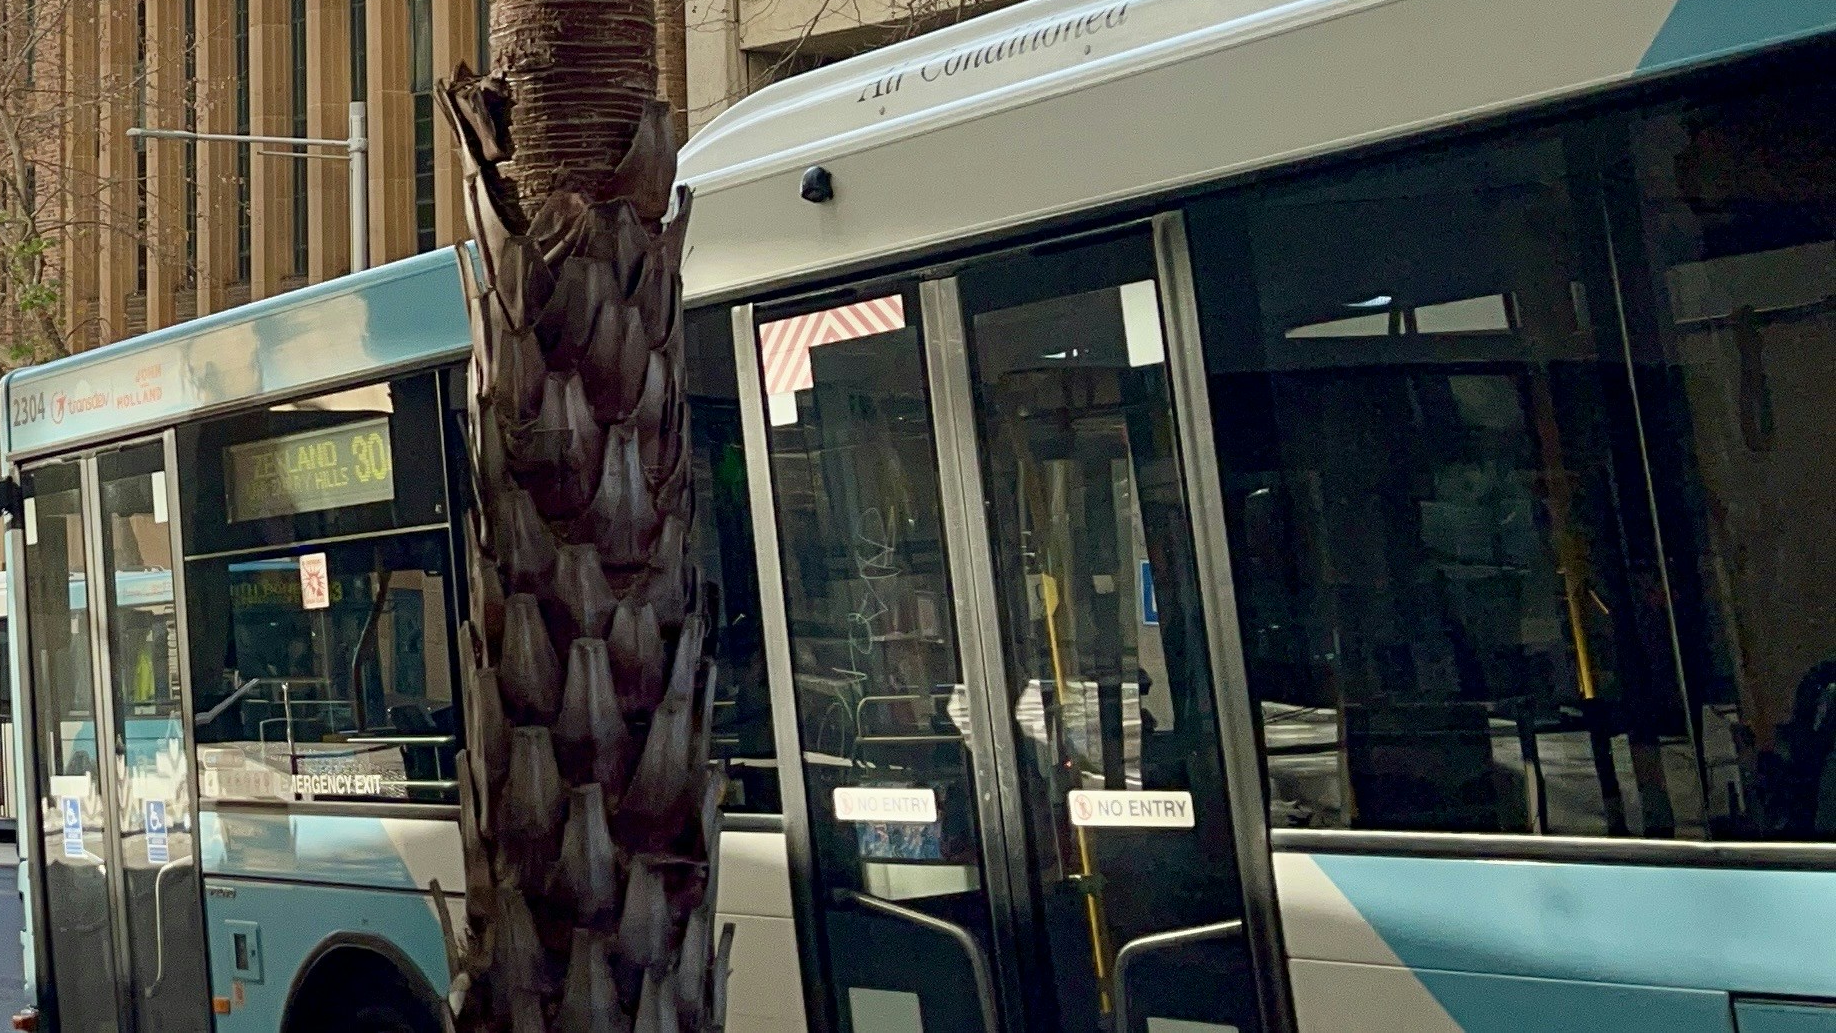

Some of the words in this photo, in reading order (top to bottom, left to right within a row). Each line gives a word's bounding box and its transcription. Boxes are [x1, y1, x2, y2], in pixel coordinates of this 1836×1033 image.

[858, 61, 909, 103] Air
[13, 392, 45, 428] 2304
[116, 386, 162, 410] HOLLAND
[251, 440, 338, 480] ZELAND
[351, 432, 388, 483] 30
[355, 774, 381, 794] EXIT
[858, 797, 877, 812] NO
[882, 797, 930, 813] ENTRY
[1098, 799, 1123, 816] NO
[1128, 800, 1187, 818] ENTRY
